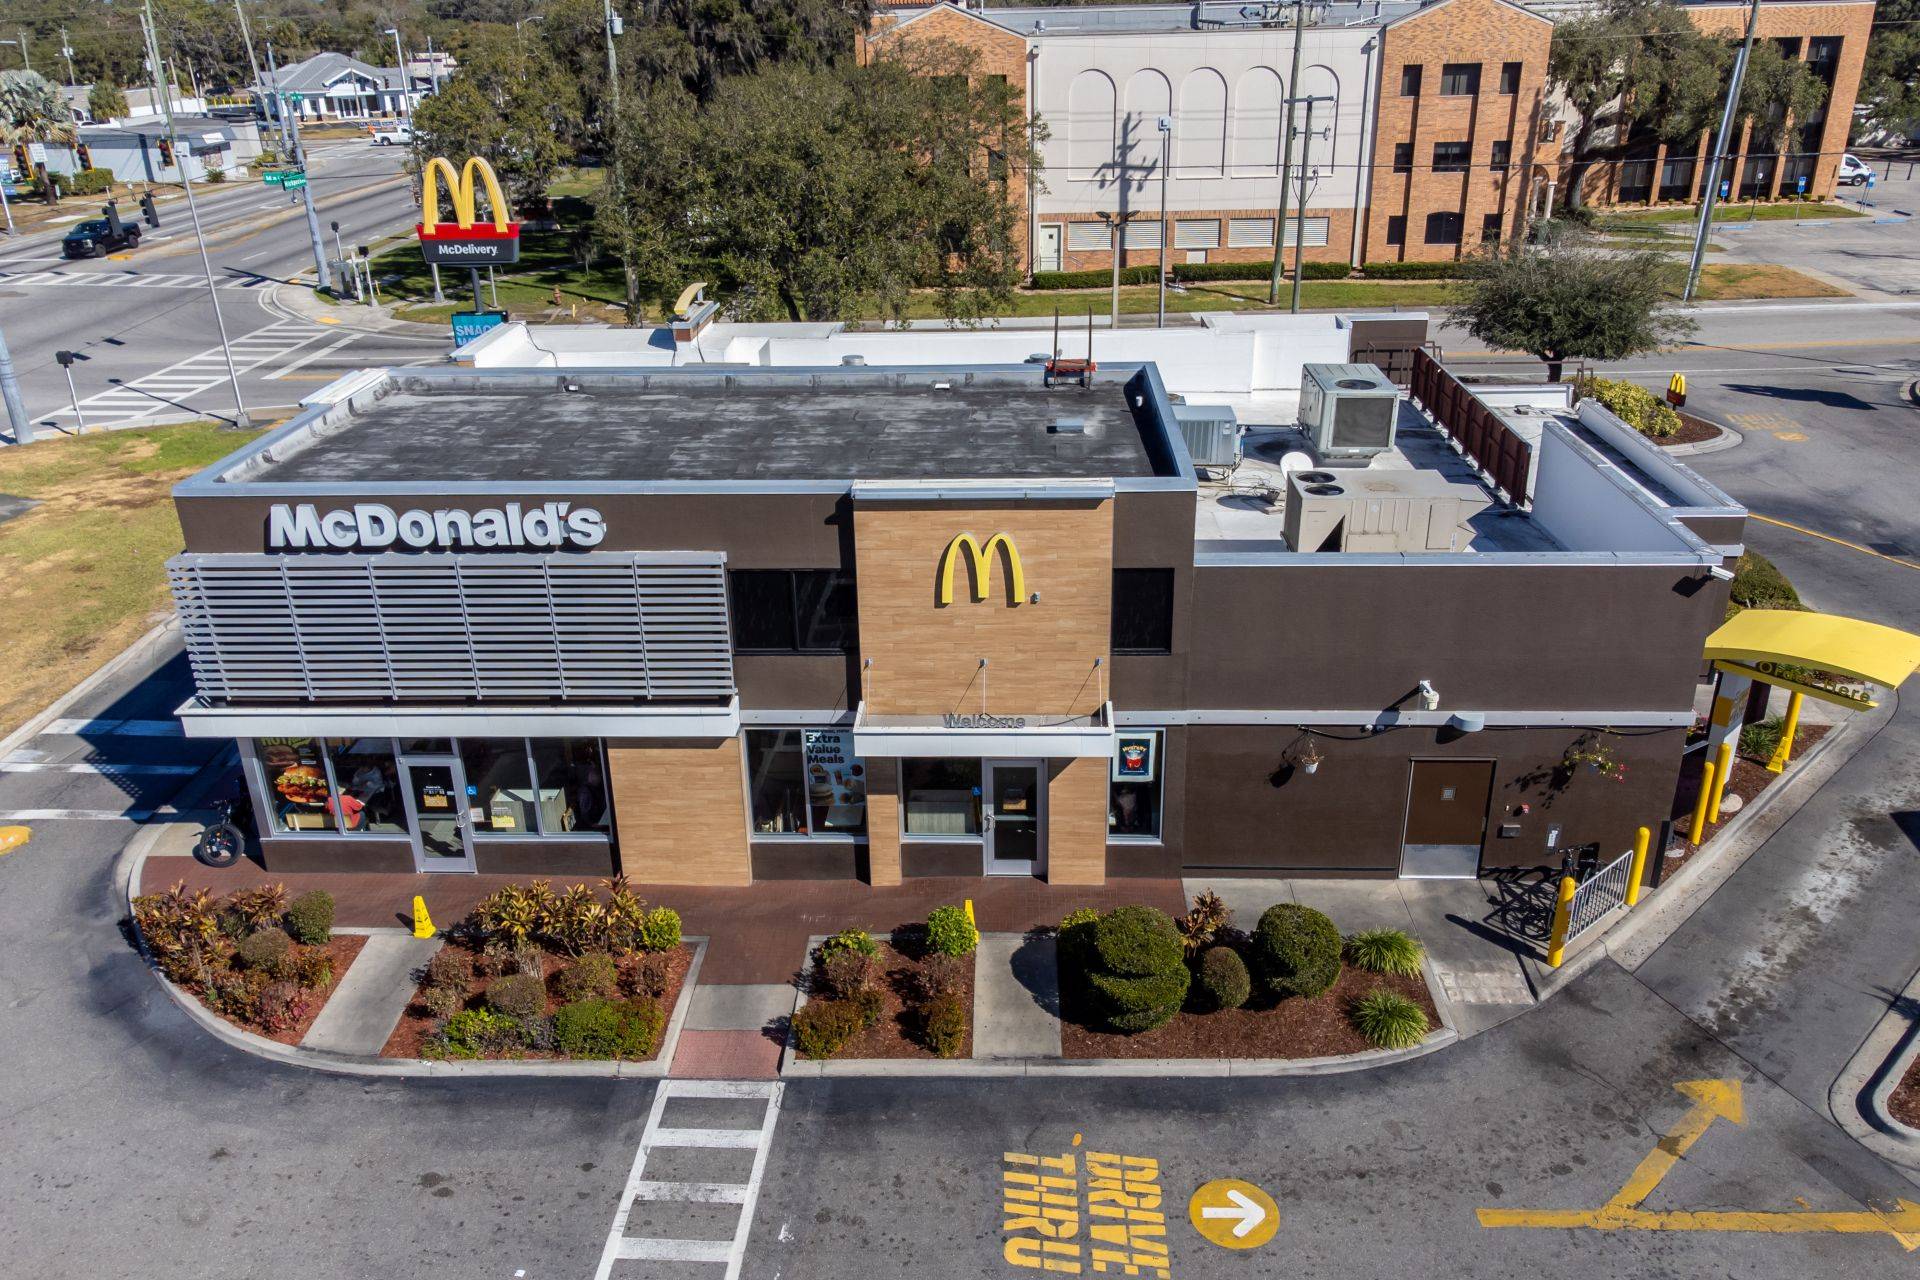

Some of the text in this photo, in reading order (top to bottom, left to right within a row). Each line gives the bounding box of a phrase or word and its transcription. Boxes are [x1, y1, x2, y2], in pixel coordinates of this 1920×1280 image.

[438, 243, 498, 256] McDelivery
[456, 324, 493, 336] SNAC
[270, 503, 606, 548] McDonald's
[942, 713, 1025, 729] Welcome
[805, 734, 841, 743] Extra
[806, 744, 841, 754] Value
[807, 754, 845, 764] Meals
[1003, 1151, 1081, 1274] THRU
[1085, 1151, 1171, 1279] DRIVE
